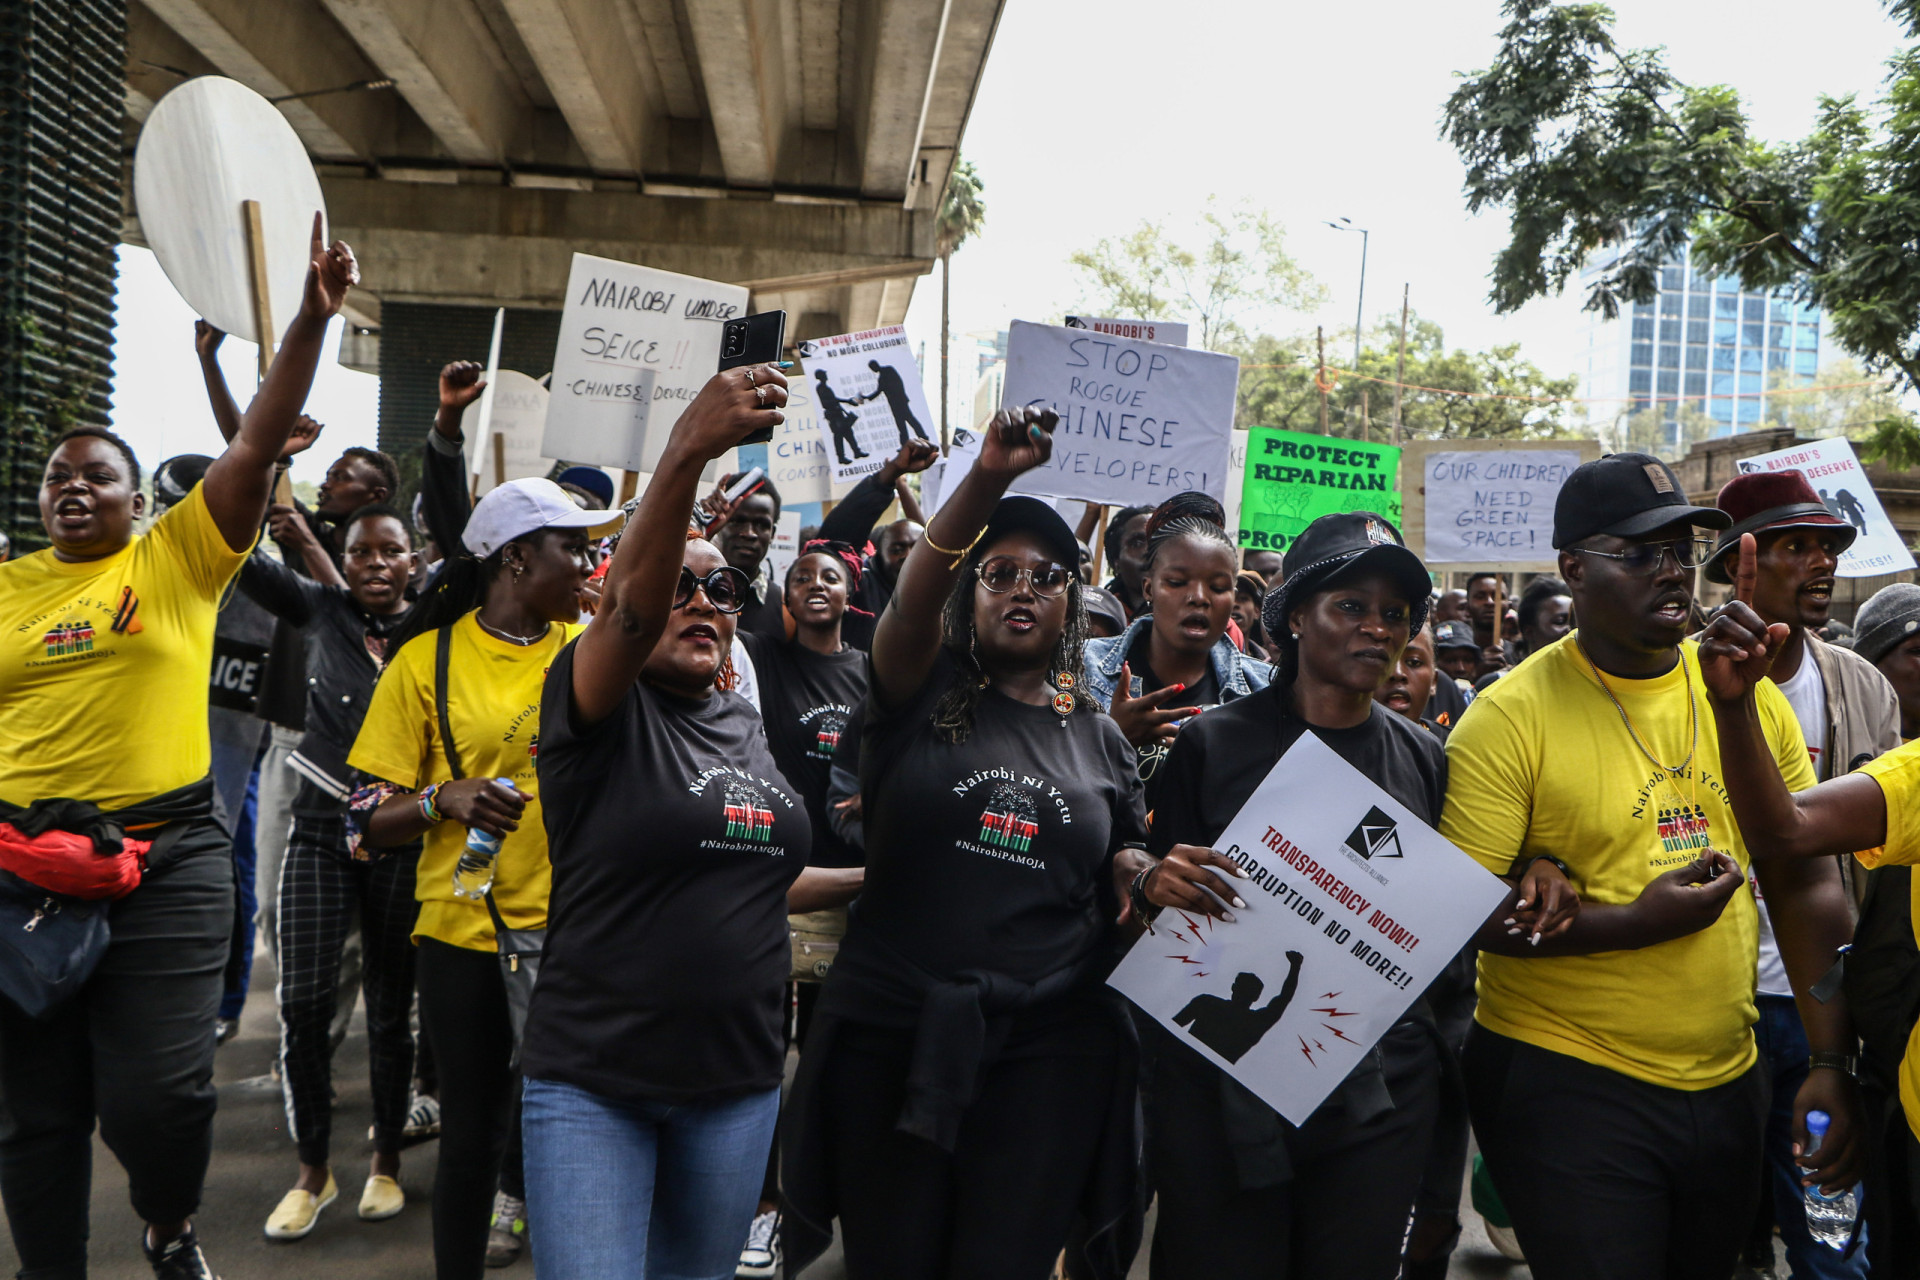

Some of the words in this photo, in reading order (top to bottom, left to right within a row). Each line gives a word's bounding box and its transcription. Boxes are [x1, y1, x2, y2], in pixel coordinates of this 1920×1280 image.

[580, 278, 676, 314] NAIROBI
[685, 298, 738, 320] UNDER
[819, 338, 830, 347] NO
[832, 335, 852, 345] MORE
[854, 325, 905, 341] CORRUPTION!!
[1093, 322, 1155, 340] NAIROBI'S
[580, 327, 660, 364] SEIGE
[827, 349, 838, 358] NO
[840, 345, 860, 356] MORE
[862, 336, 907, 352] COLLUSION!!
[1066, 338, 1168, 382] STOP
[653, 385, 700, 402] DEVELO
[1069, 376, 1147, 408] ROGUE
[777, 441, 826, 458] CHIN
[1264, 438, 1381, 469] PROTECT
[1766, 449, 1821, 471] NAIROBI'S
[839, 462, 887, 478] #ENDILLEGA
[1039, 448, 1208, 491] VELOPERS!
[1254, 463, 1387, 491] RIPARIAN
[1433, 461, 1479, 481] OUR
[1807, 459, 1855, 479] DESERVE
[1474, 490, 1533, 508] NEED
[1456, 510, 1528, 527] GREEN
[211, 654, 260, 694] ICE
[799, 702, 835, 725] Nairobi
[837, 704, 851, 715] Ni
[689, 765, 732, 797] Nairobi
[952, 766, 1016, 799] Nairobi
[1021, 775, 1045, 789] Ni
[1048, 786, 1072, 825] Yetu
[1632, 771, 1667, 820] Nairob
[1701, 771, 1731, 806] Yetu
[700, 840, 785, 856] #NairobiPAMOJA
[955, 839, 1046, 870] #NairobiPAMOJA
[1260, 825, 1372, 916] TRANSPARENCY
[1367, 910, 1420, 954] NOW!!
[1225, 845, 1325, 925] CORRUPTION
[1323, 920, 1352, 946] NO
[1349, 939, 1415, 991] MORE!!
